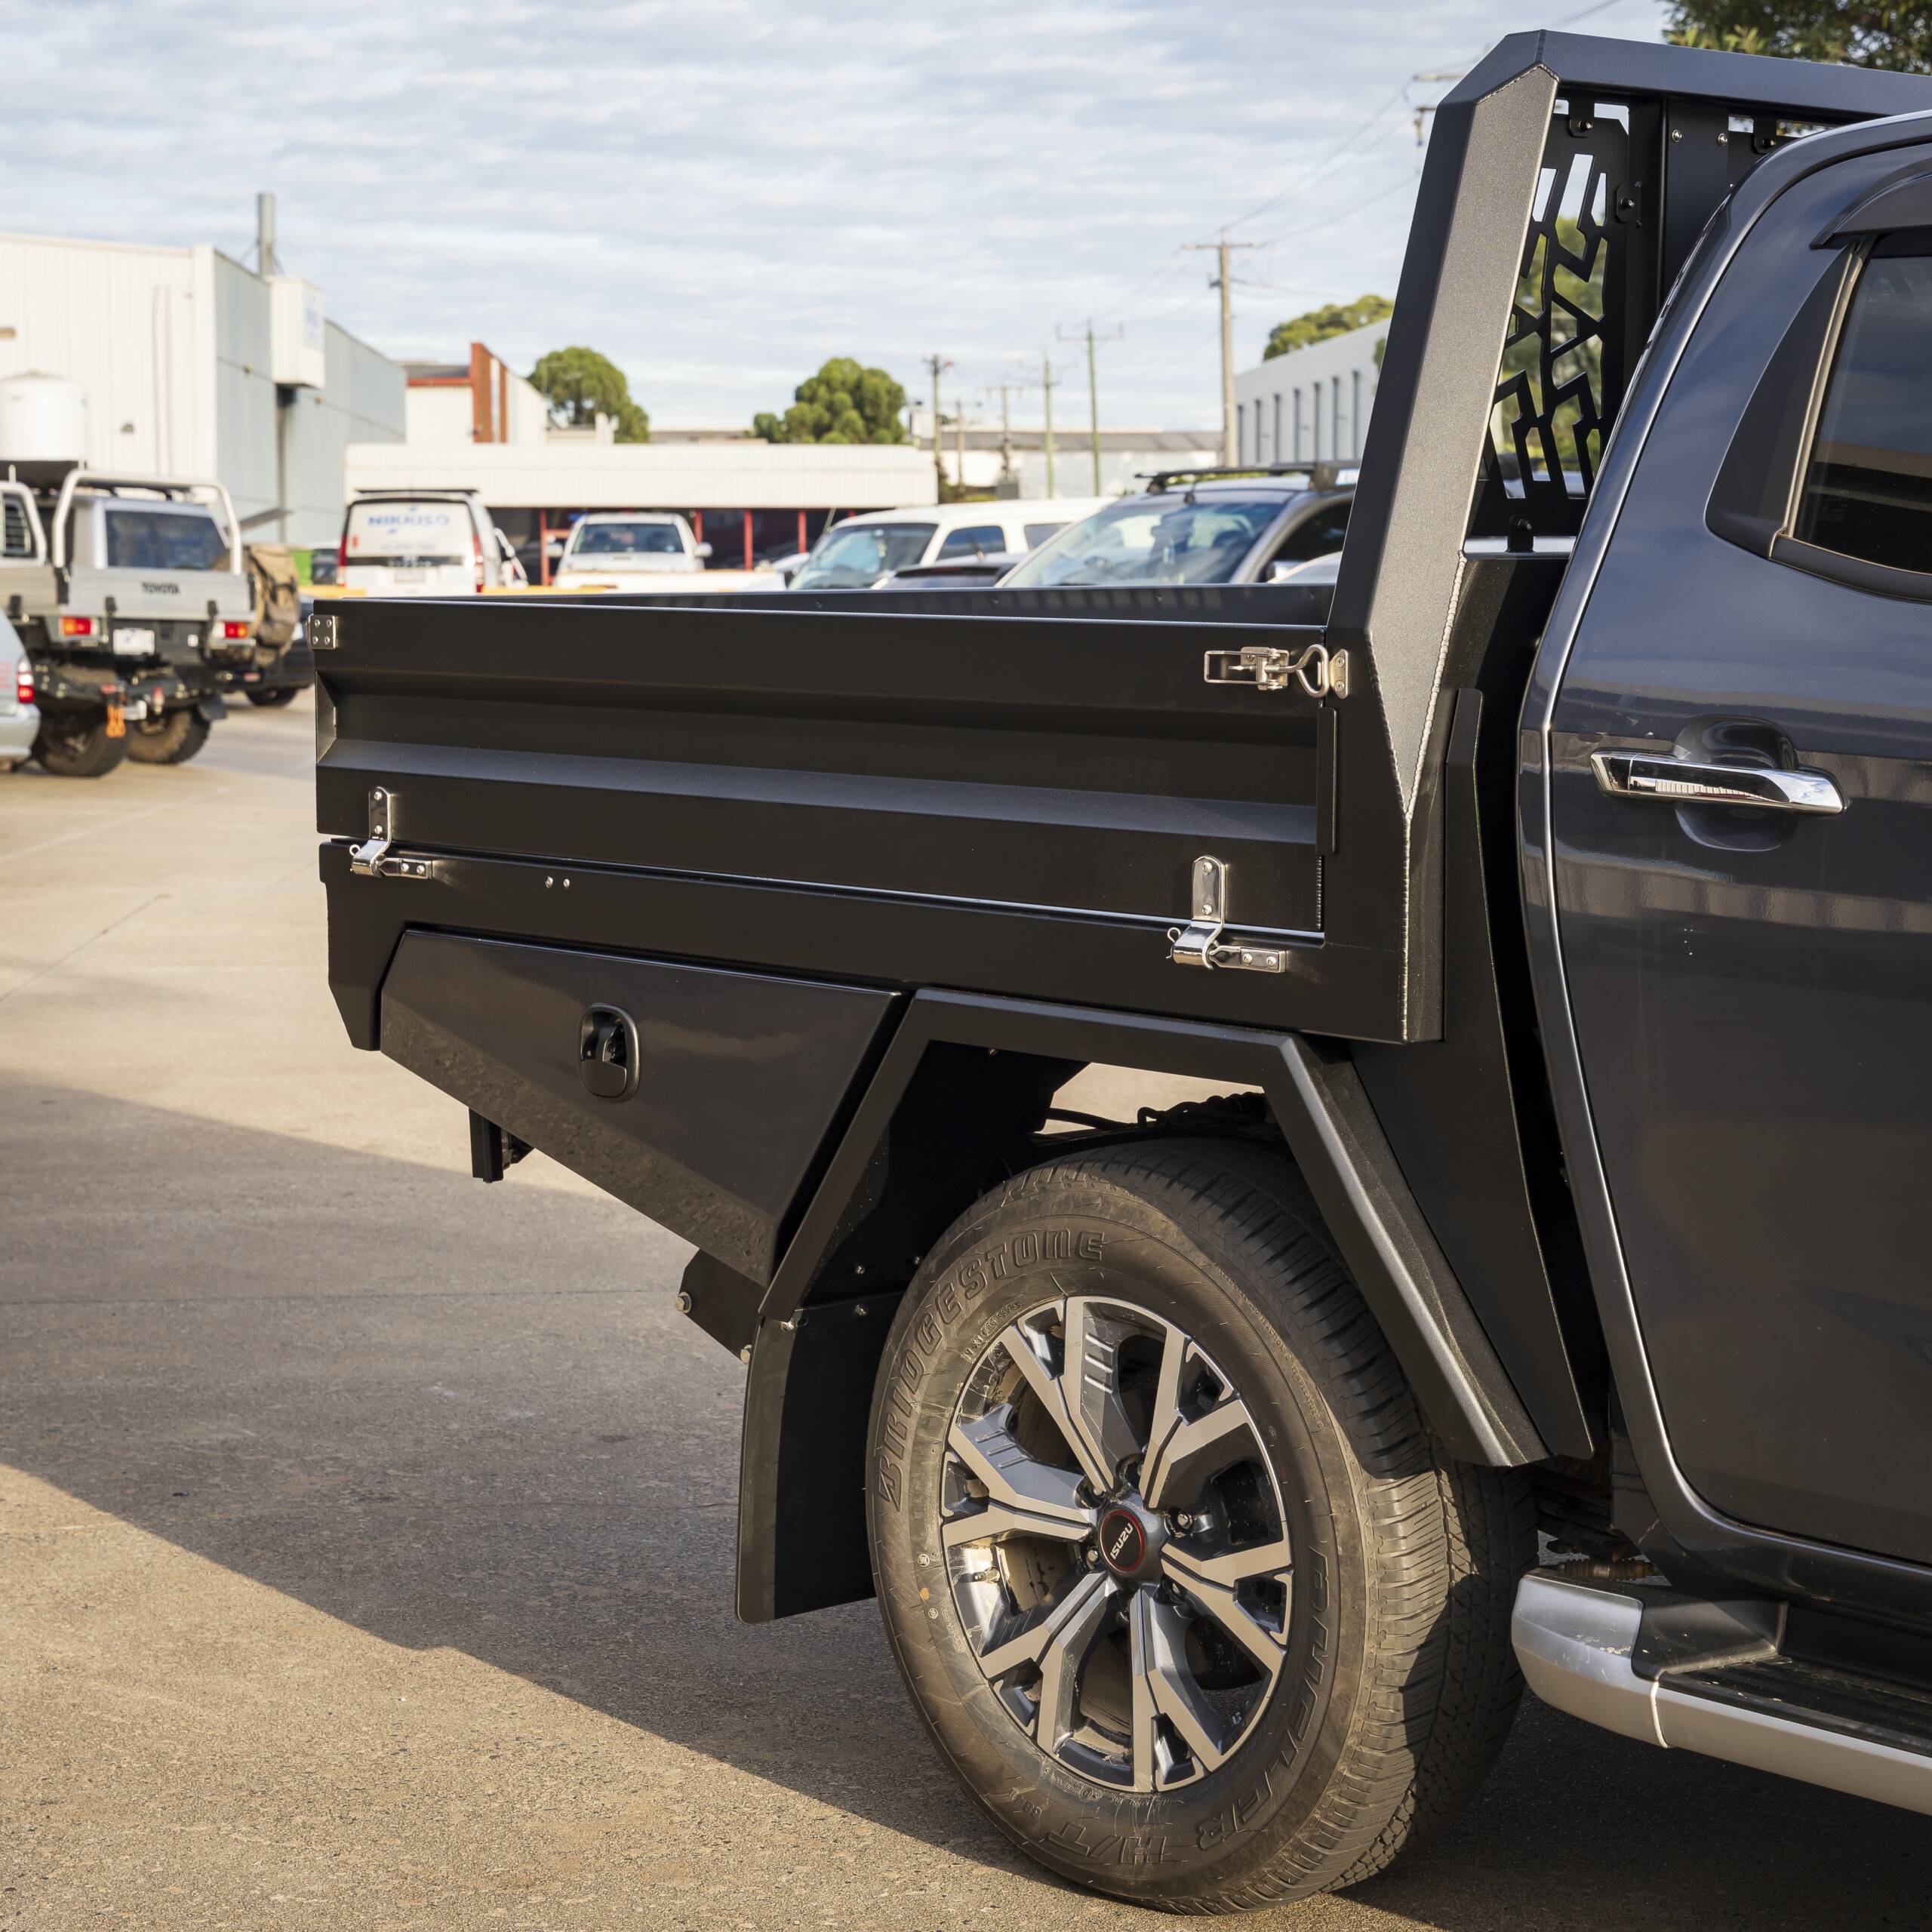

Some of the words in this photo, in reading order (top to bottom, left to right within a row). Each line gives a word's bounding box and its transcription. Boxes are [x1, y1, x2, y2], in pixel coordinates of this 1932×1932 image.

[142, 581, 180, 595] TOYOTA
[878, 1229, 1105, 1512] BRIDGESTONE
[1110, 1523, 1134, 1560] ISUZU
[1197, 1545, 1330, 1850] DUELER
